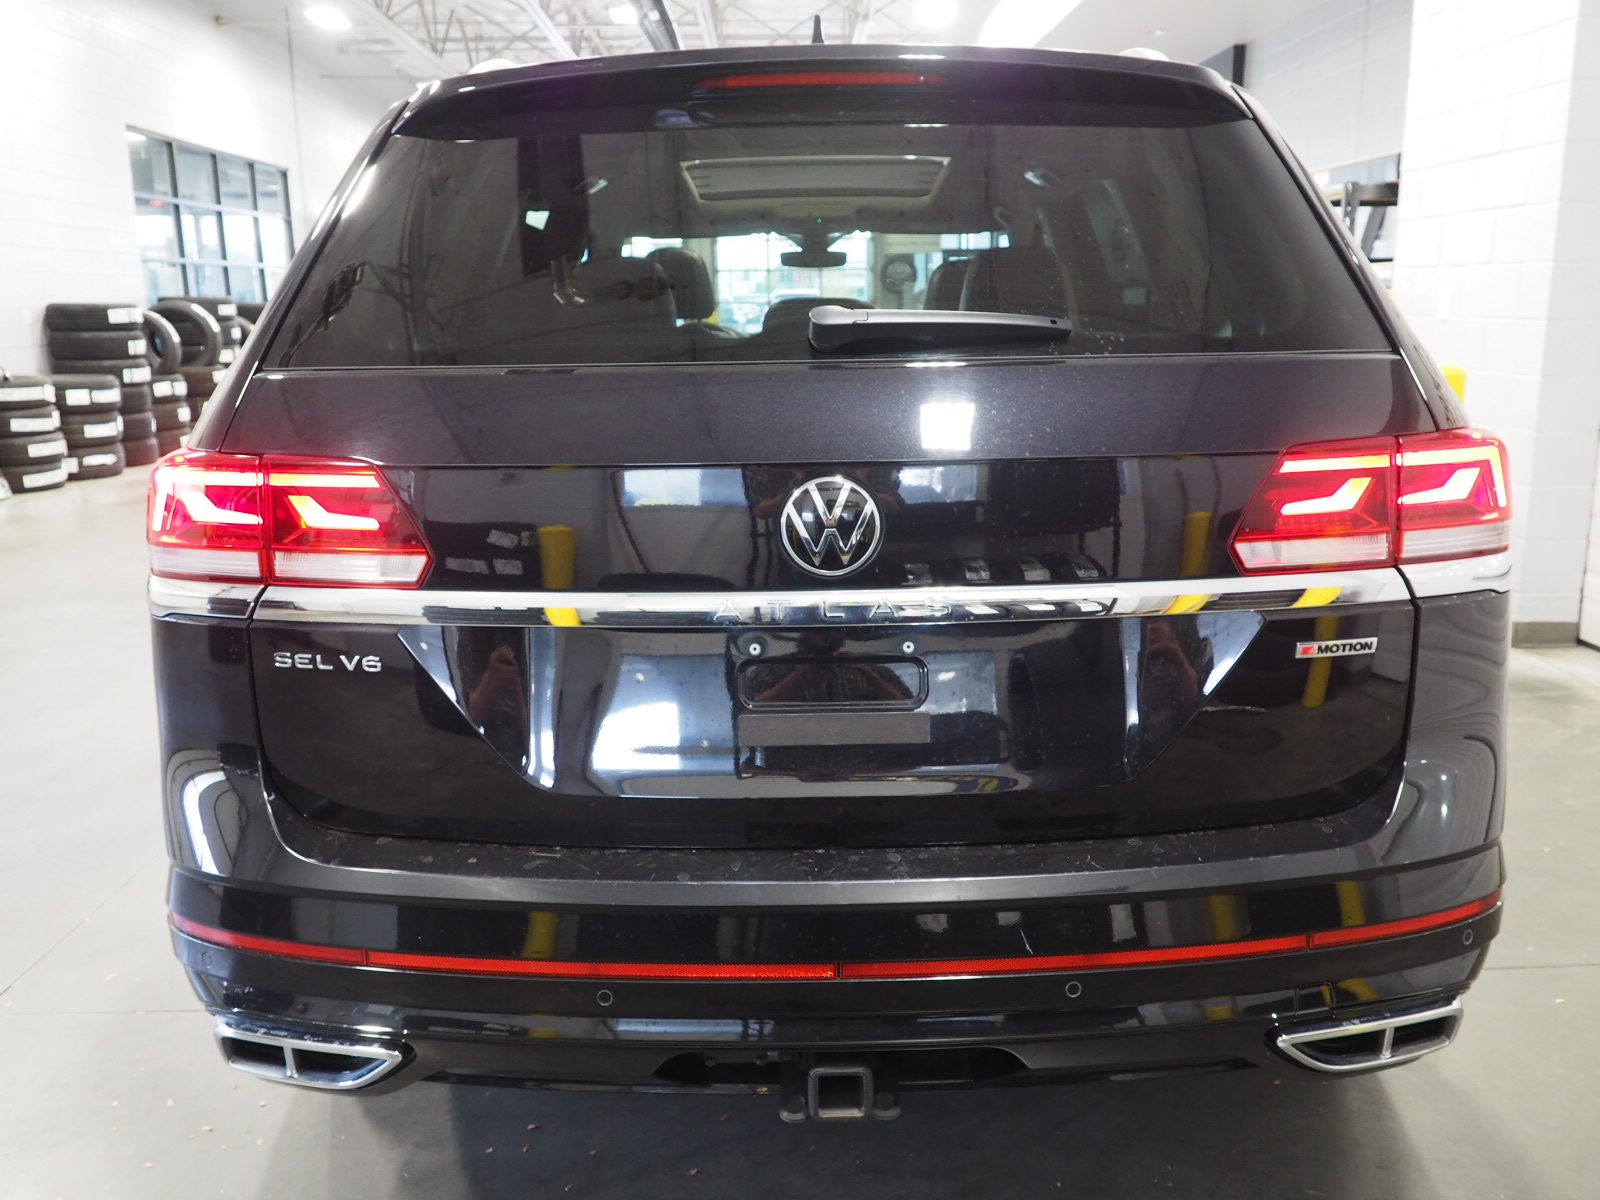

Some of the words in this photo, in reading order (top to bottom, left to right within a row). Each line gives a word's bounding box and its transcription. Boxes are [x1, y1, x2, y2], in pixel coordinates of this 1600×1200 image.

[713, 598, 951, 620] ATLAS
[273, 652, 334, 670] SEL
[339, 655, 382, 672] V6
